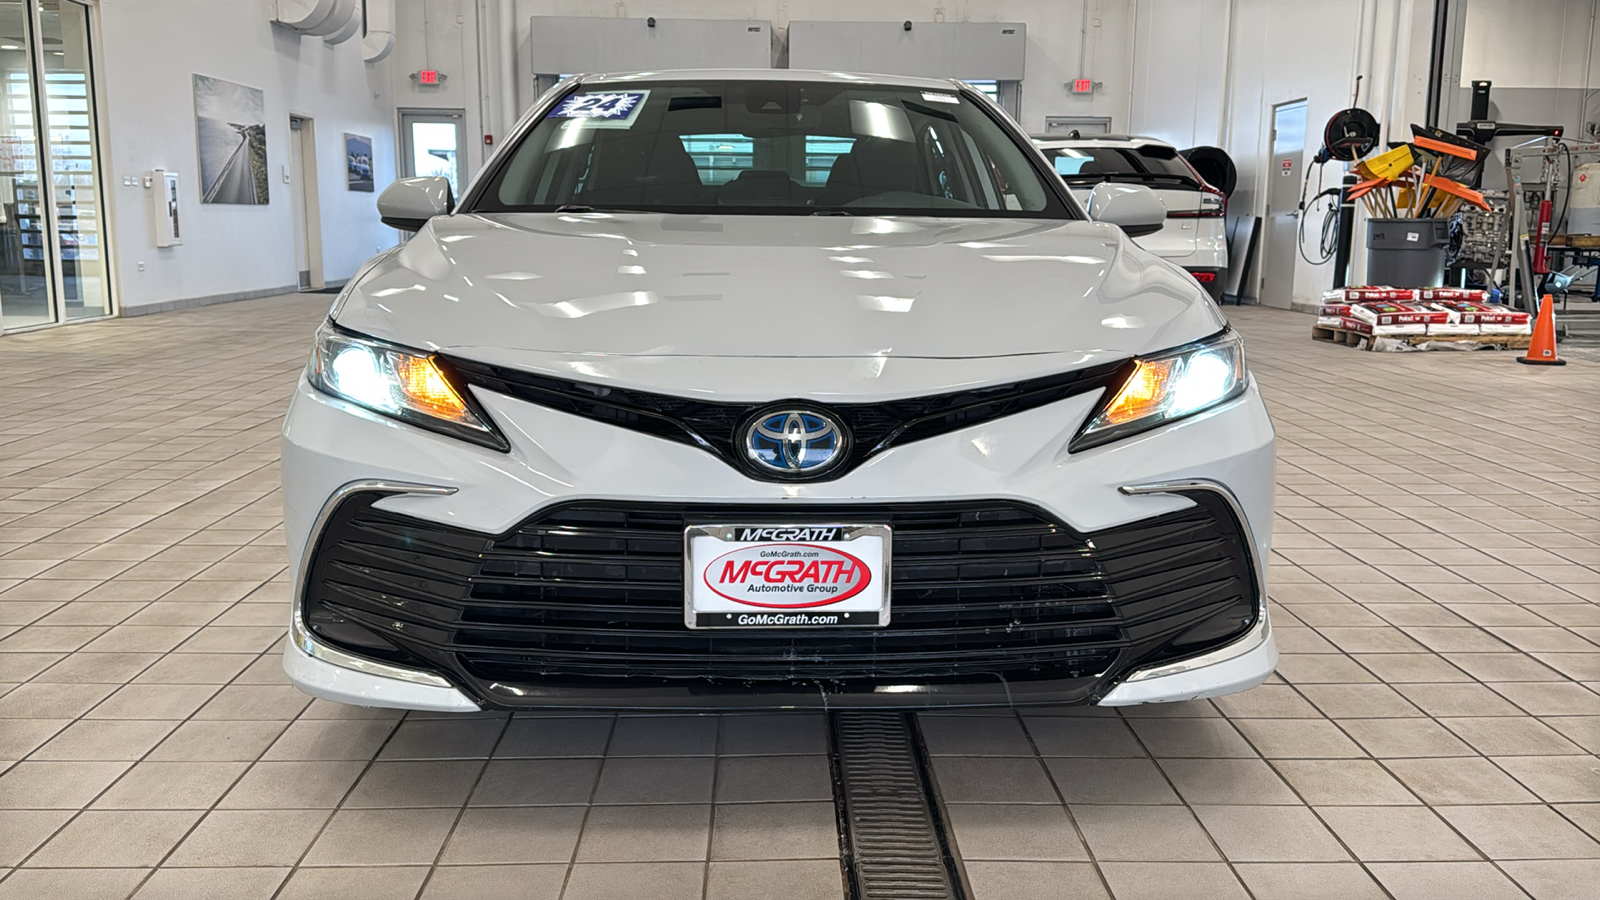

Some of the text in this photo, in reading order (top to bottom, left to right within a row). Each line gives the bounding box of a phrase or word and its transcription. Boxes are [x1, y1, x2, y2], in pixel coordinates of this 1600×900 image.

[421, 70, 436, 84] EXIT
[1075, 79, 1091, 92] EXIT
[573, 97, 622, 112] 24
[759, 550, 819, 558] GoMcGrath.com
[718, 559, 857, 584] McGRATH
[747, 583, 838, 595] Automotive Group
[737, 613, 839, 625] GoMcGrath.com
